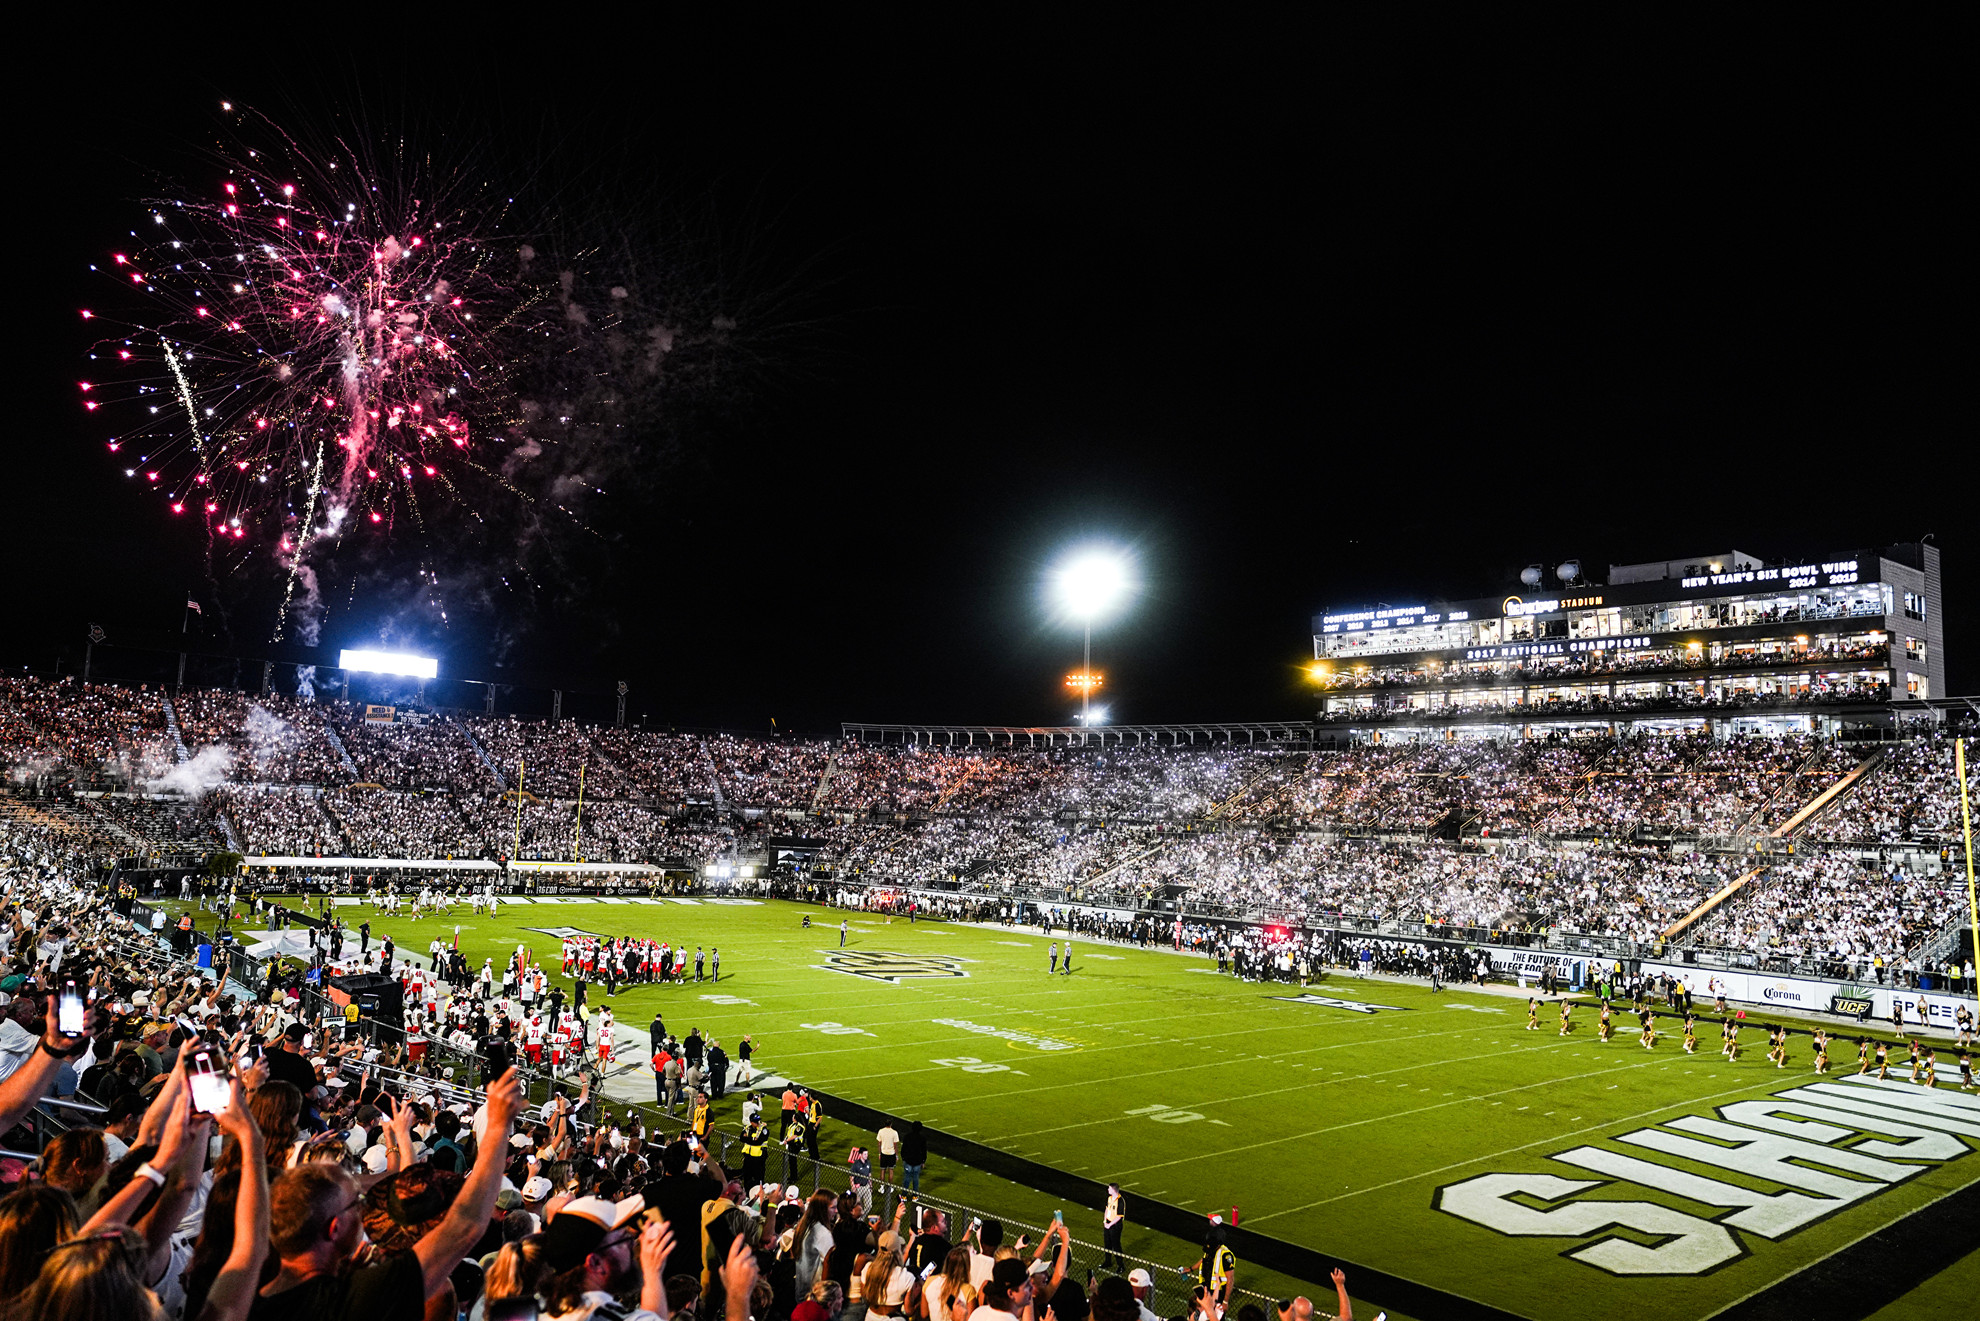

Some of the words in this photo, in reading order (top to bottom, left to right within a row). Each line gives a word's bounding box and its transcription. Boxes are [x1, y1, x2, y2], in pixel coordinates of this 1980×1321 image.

[1682, 577, 1708, 588] NEW
[1711, 572, 1754, 585] YEAR'S
[1757, 569, 1778, 580] SIX
[1781, 565, 1819, 578] BOWL
[1822, 561, 1857, 574] WINS
[1789, 577, 1816, 588] 2014
[1561, 596, 1603, 608] STADIUM
[1323, 611, 1375, 624] CONFERENCE
[1376, 606, 1426, 619] CHAMPIONS
[1467, 649, 1495, 659] 2017
[1501, 644, 1563, 656] NATIONAL
[1570, 637, 1650, 651] CHAMPIONS
[1579, 939, 1590, 947] 112
[1512, 952, 1526, 962] THE
[1527, 954, 1561, 966] FUTURE
[1562, 957, 1573, 967] OF
[1763, 987, 1801, 1001] Corona
[500, 1001, 508, 1010] 10
[1835, 998, 1871, 1014] UCF
[1893, 1000, 1952, 1018] SPCE
[563, 1014, 572, 1023] 46
[531, 1029, 540, 1038] 71
[600, 1029, 609, 1038] 36
[799, 1021, 866, 1035] 30
[554, 1036, 563, 1044] 41
[929, 1056, 1011, 1074] 20
[1123, 1104, 1206, 1124] 10
